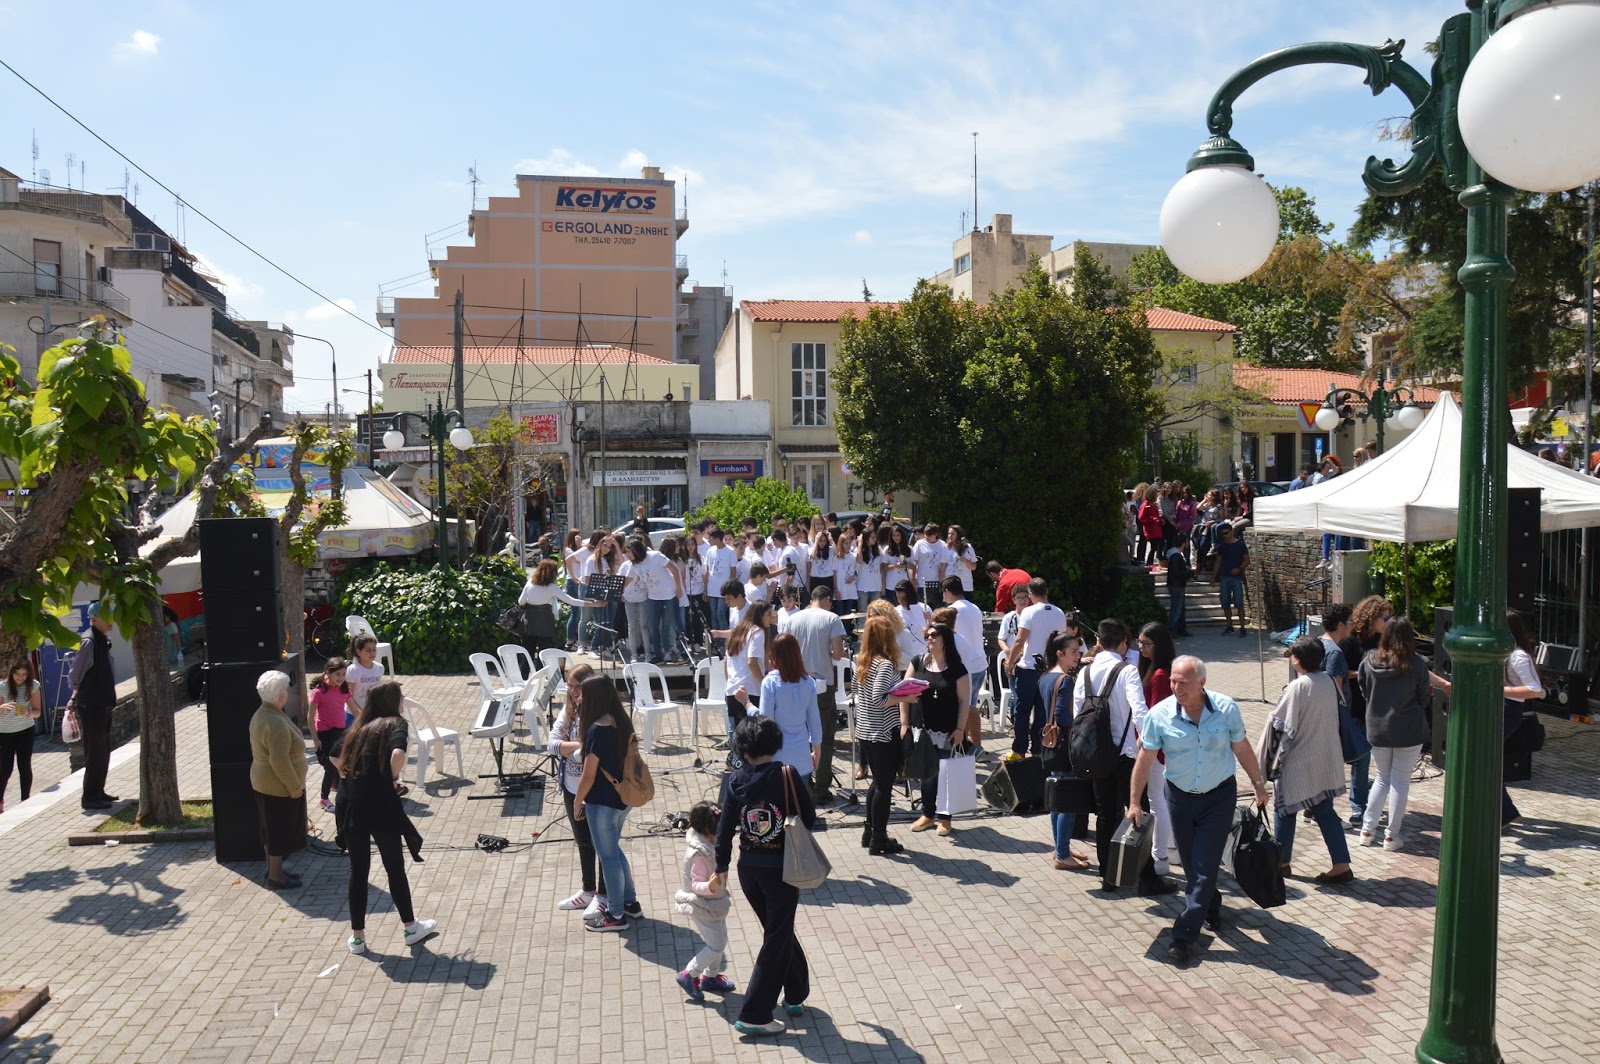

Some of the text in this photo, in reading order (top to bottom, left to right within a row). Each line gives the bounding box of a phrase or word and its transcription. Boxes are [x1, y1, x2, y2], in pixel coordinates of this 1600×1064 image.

[555, 188, 657, 212] Kelyfos
[554, 221, 669, 236] ERGOLAND ΞΑΝΘΗΣ
[714, 465, 749, 473] Eurobank
[327, 538, 344, 546] FOX
[387, 535, 404, 545] FOX
